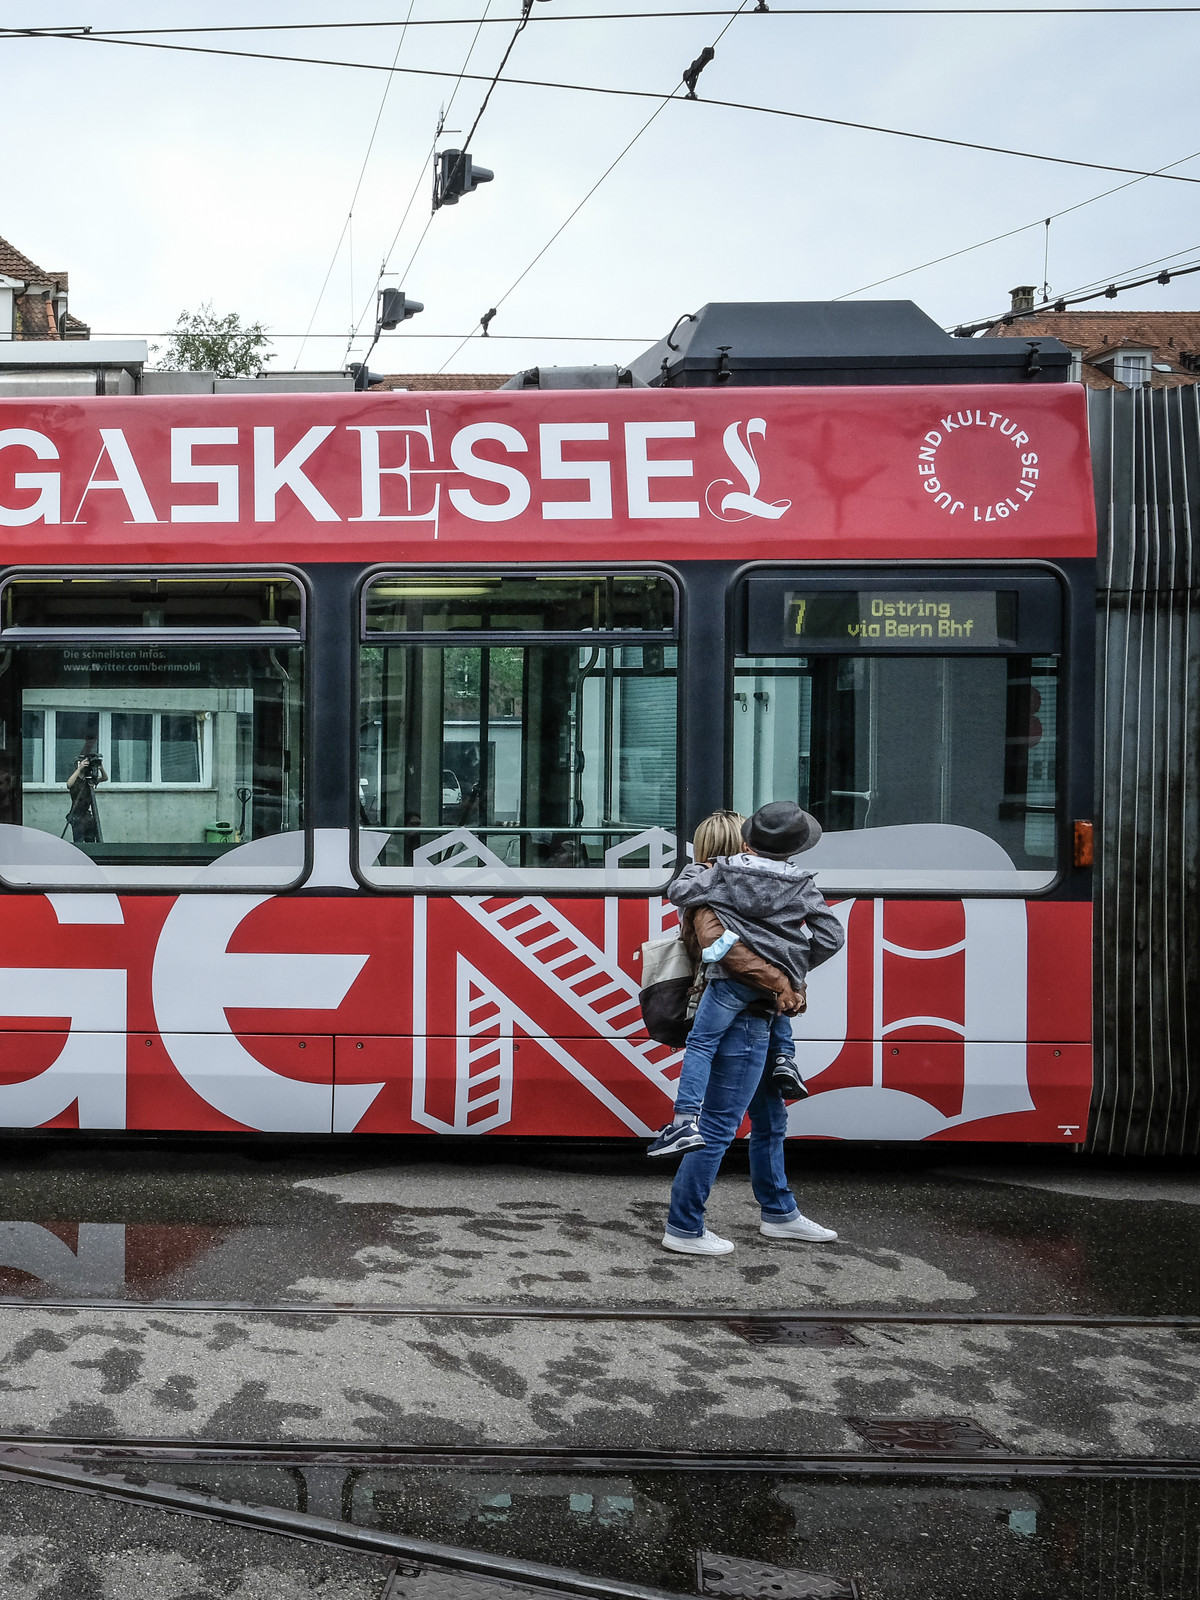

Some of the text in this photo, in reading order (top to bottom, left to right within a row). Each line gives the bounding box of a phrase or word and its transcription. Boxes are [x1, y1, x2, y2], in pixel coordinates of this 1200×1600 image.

[918, 409, 1039, 522] JUGEND KULTUR SEIT 1971
[789, 599, 806, 635] 7
[871, 599, 951, 617] Ostring
[847, 619, 974, 637] via Bern Bhf
[63, 649, 167, 659] Die schnellsten Infos.
[63, 662, 201, 673] www.twitter.com/bernmobil
